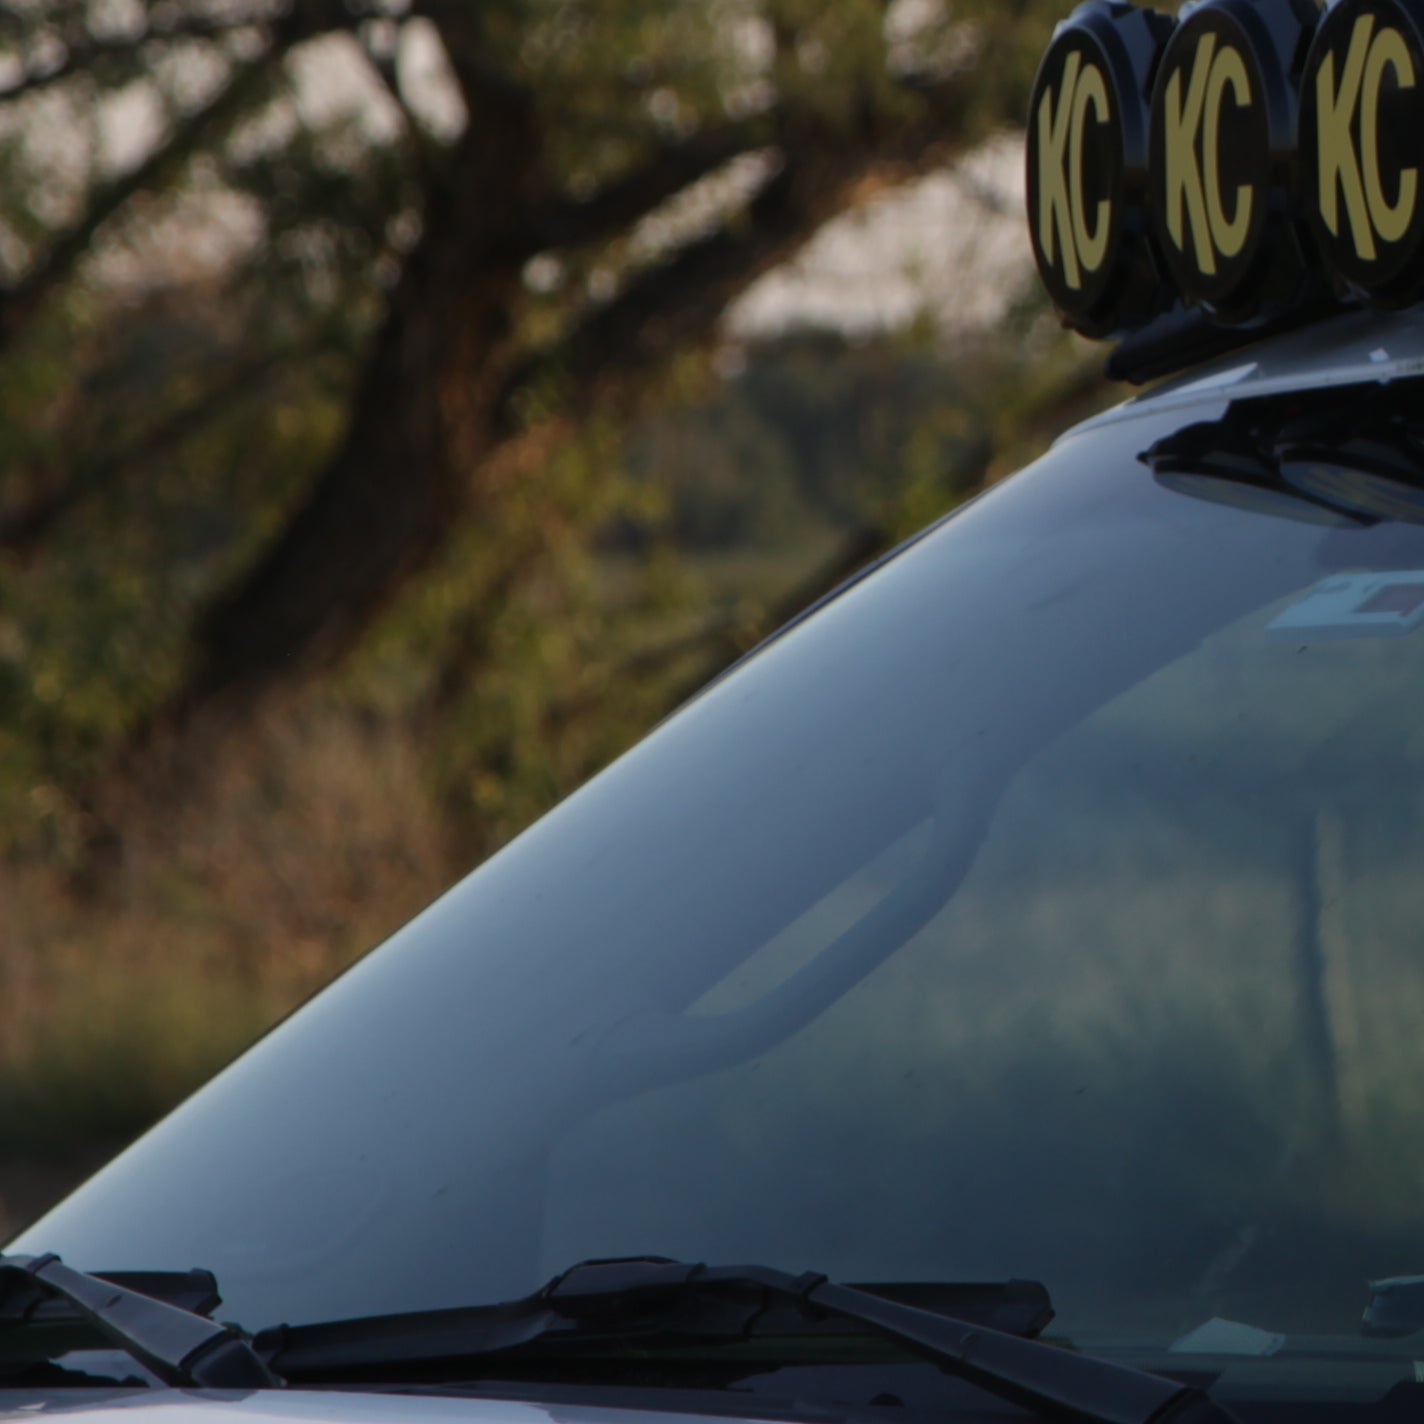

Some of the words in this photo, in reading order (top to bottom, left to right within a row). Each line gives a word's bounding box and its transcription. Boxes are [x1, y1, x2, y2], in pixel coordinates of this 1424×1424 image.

[1039, 51, 1111, 289] KC
[1165, 31, 1254, 276] KC
[1316, 13, 1418, 261] KC
